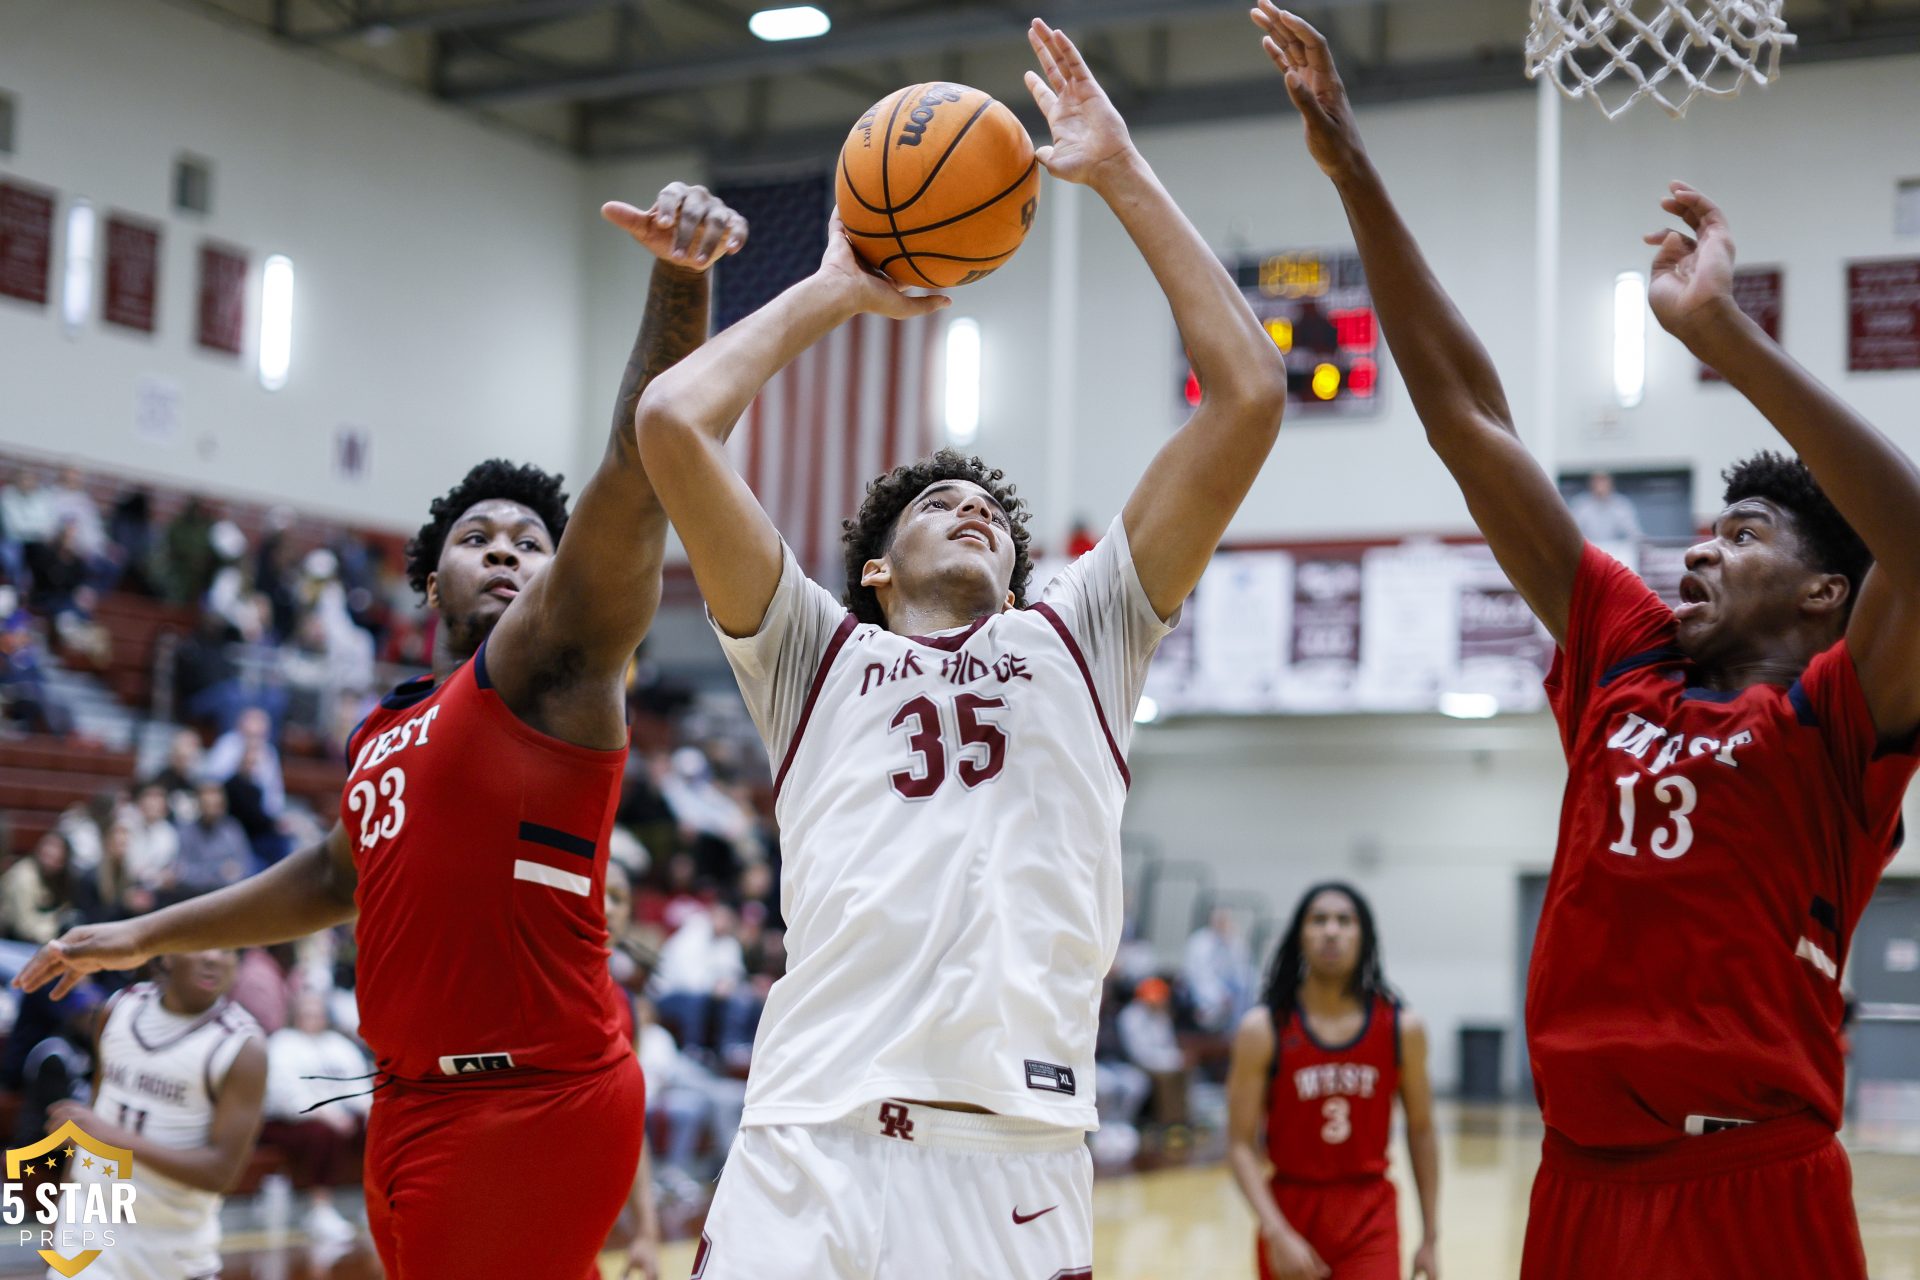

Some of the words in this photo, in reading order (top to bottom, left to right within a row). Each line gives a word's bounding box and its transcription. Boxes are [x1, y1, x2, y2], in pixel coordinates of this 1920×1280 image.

[887, 691, 1011, 802] 35
[348, 767, 405, 852] 23
[1609, 771, 1697, 859] 13
[1059, 1073, 1072, 1086] XL
[1294, 1062, 1379, 1100] WEST
[1320, 1096, 1351, 1144] 3
